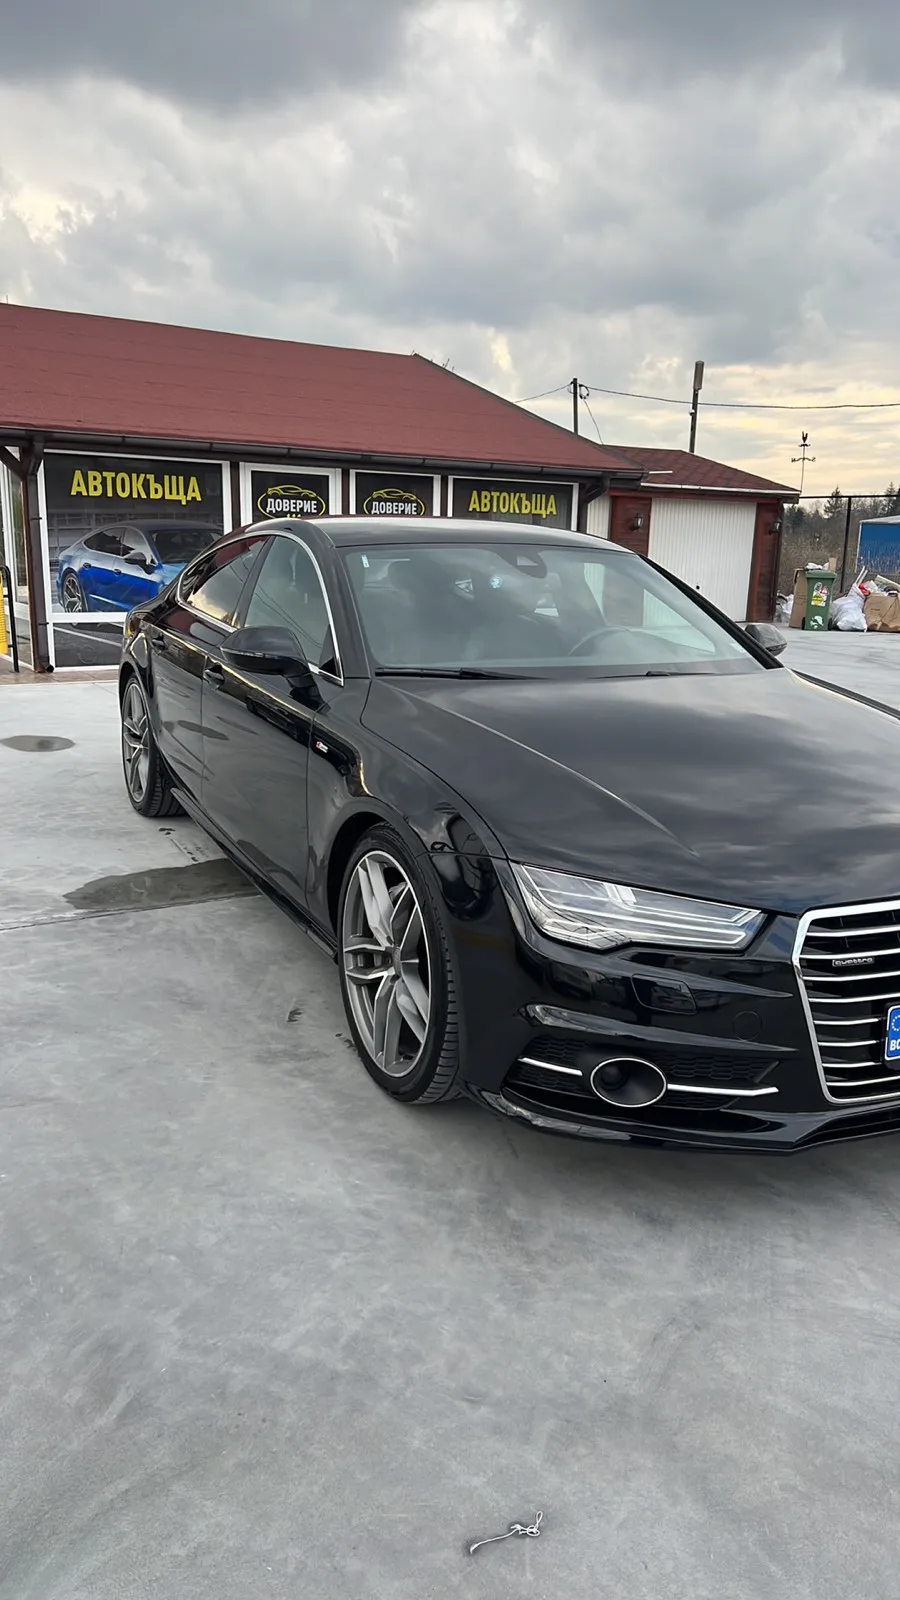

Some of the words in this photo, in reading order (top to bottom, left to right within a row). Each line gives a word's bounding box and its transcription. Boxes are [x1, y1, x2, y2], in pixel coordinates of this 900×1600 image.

[71, 469, 202, 506] АВТОКЪЩА
[265, 497, 318, 514] ДОВЕРИЕ
[370, 501, 417, 516] ДОВЕРИЕ
[468, 490, 557, 518] АВТОКЪЩА
[835, 957, 873, 966] quattro
